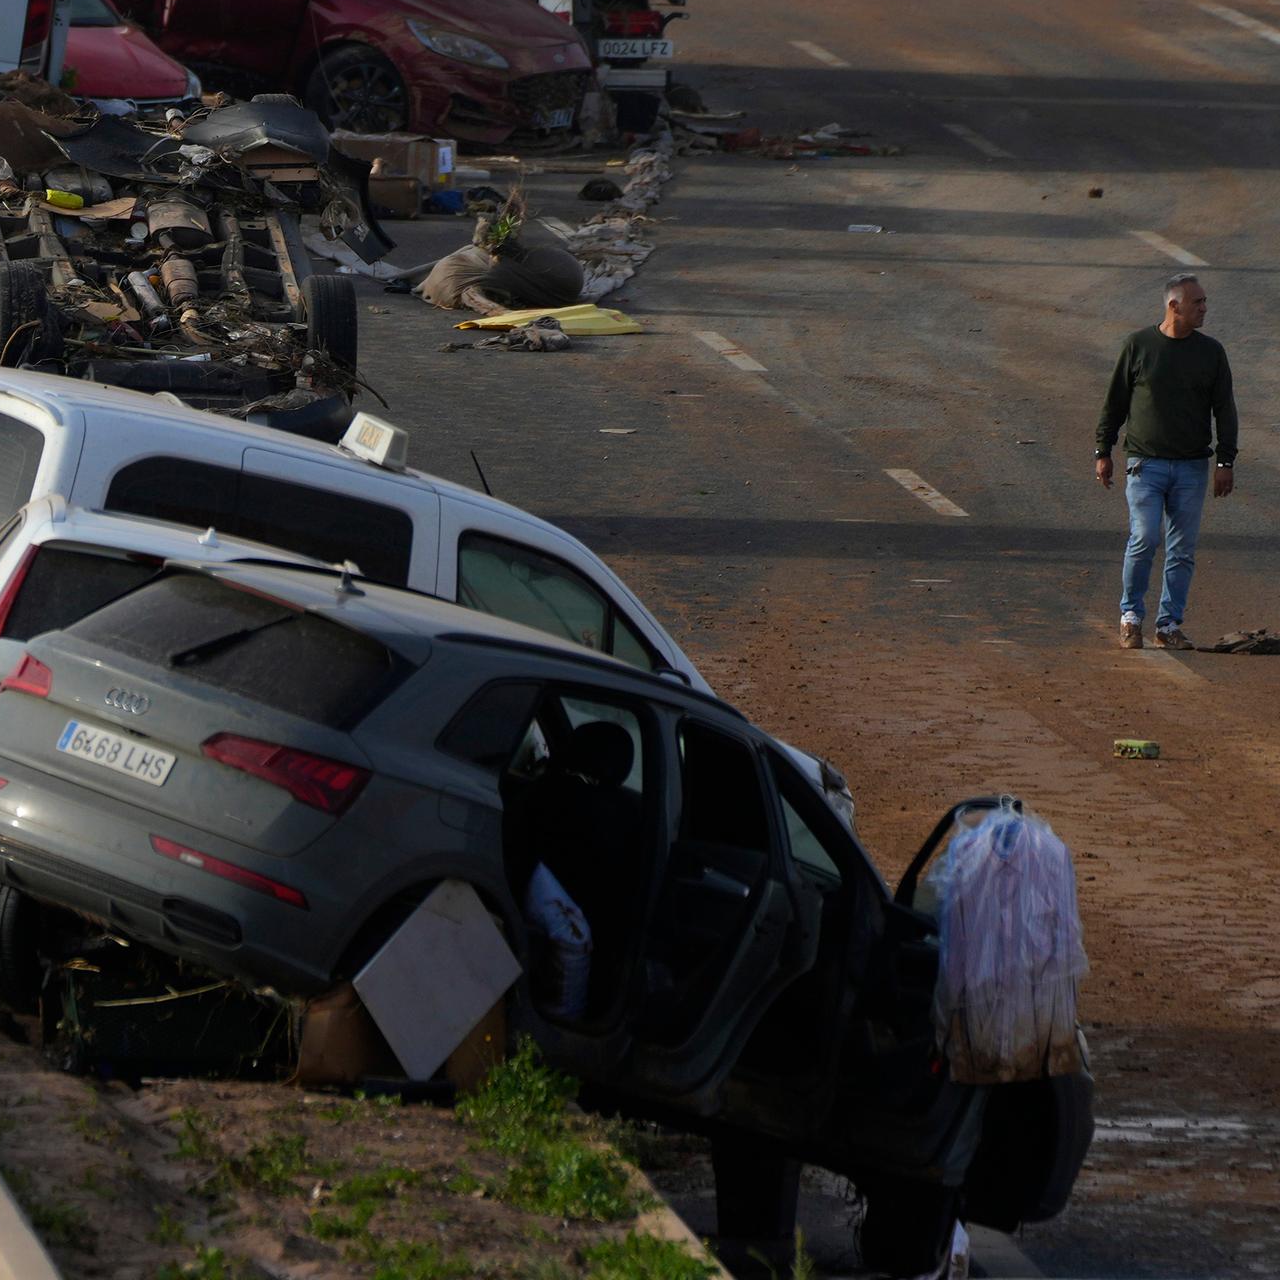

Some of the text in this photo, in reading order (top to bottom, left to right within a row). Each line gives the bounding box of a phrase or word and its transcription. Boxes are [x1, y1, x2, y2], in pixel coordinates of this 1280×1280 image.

[604, 42, 669, 56] 0024 LFZ
[357, 421, 384, 450] TAXI
[71, 730, 166, 780] 6468 LHS
